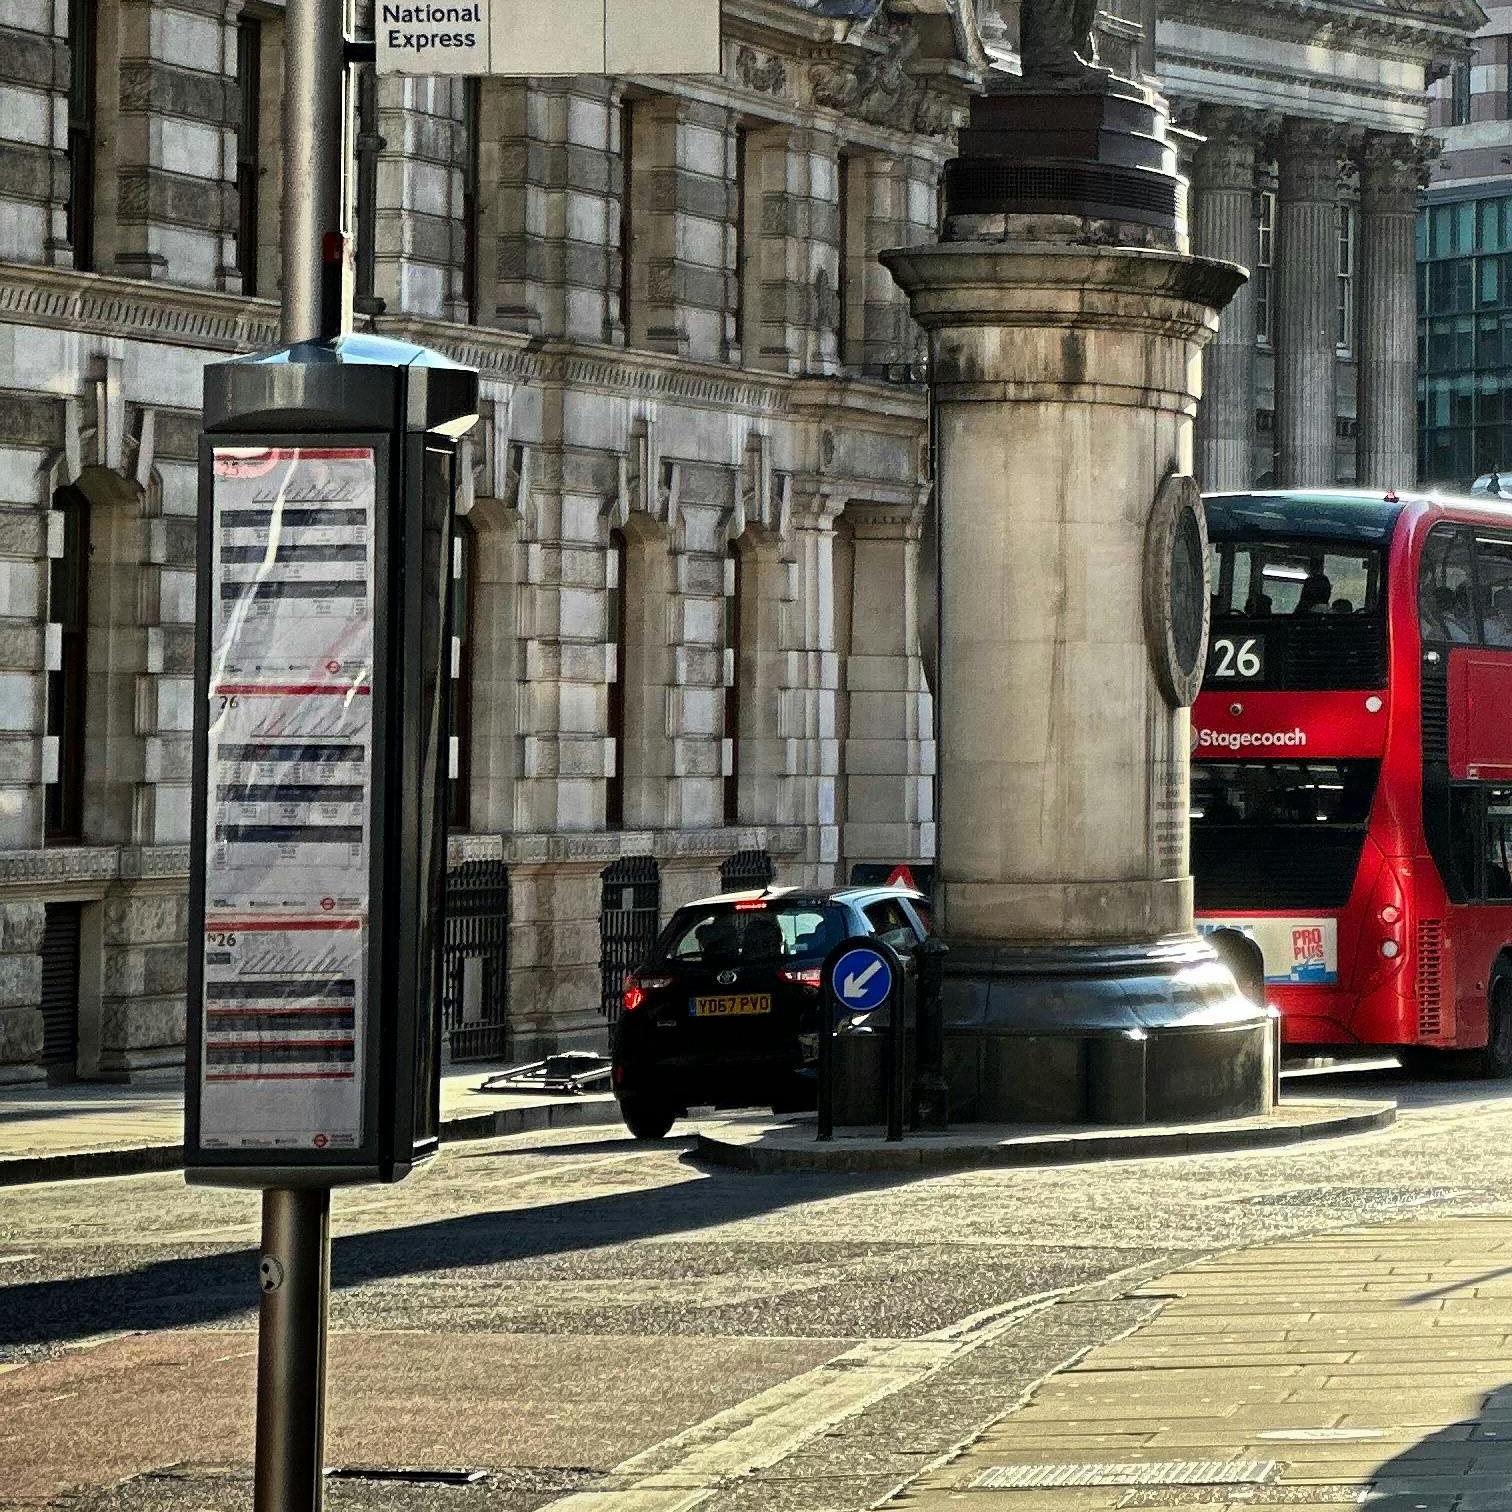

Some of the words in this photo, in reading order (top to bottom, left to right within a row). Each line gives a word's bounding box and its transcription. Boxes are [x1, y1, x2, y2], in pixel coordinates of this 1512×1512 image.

[383, 4, 481, 24] National
[388, 30, 475, 52] Express
[1214, 639, 1260, 677] 26
[1200, 728, 1306, 750] Stagecoach
[207, 933, 236, 946] N26
[1292, 928, 1321, 946] PRO
